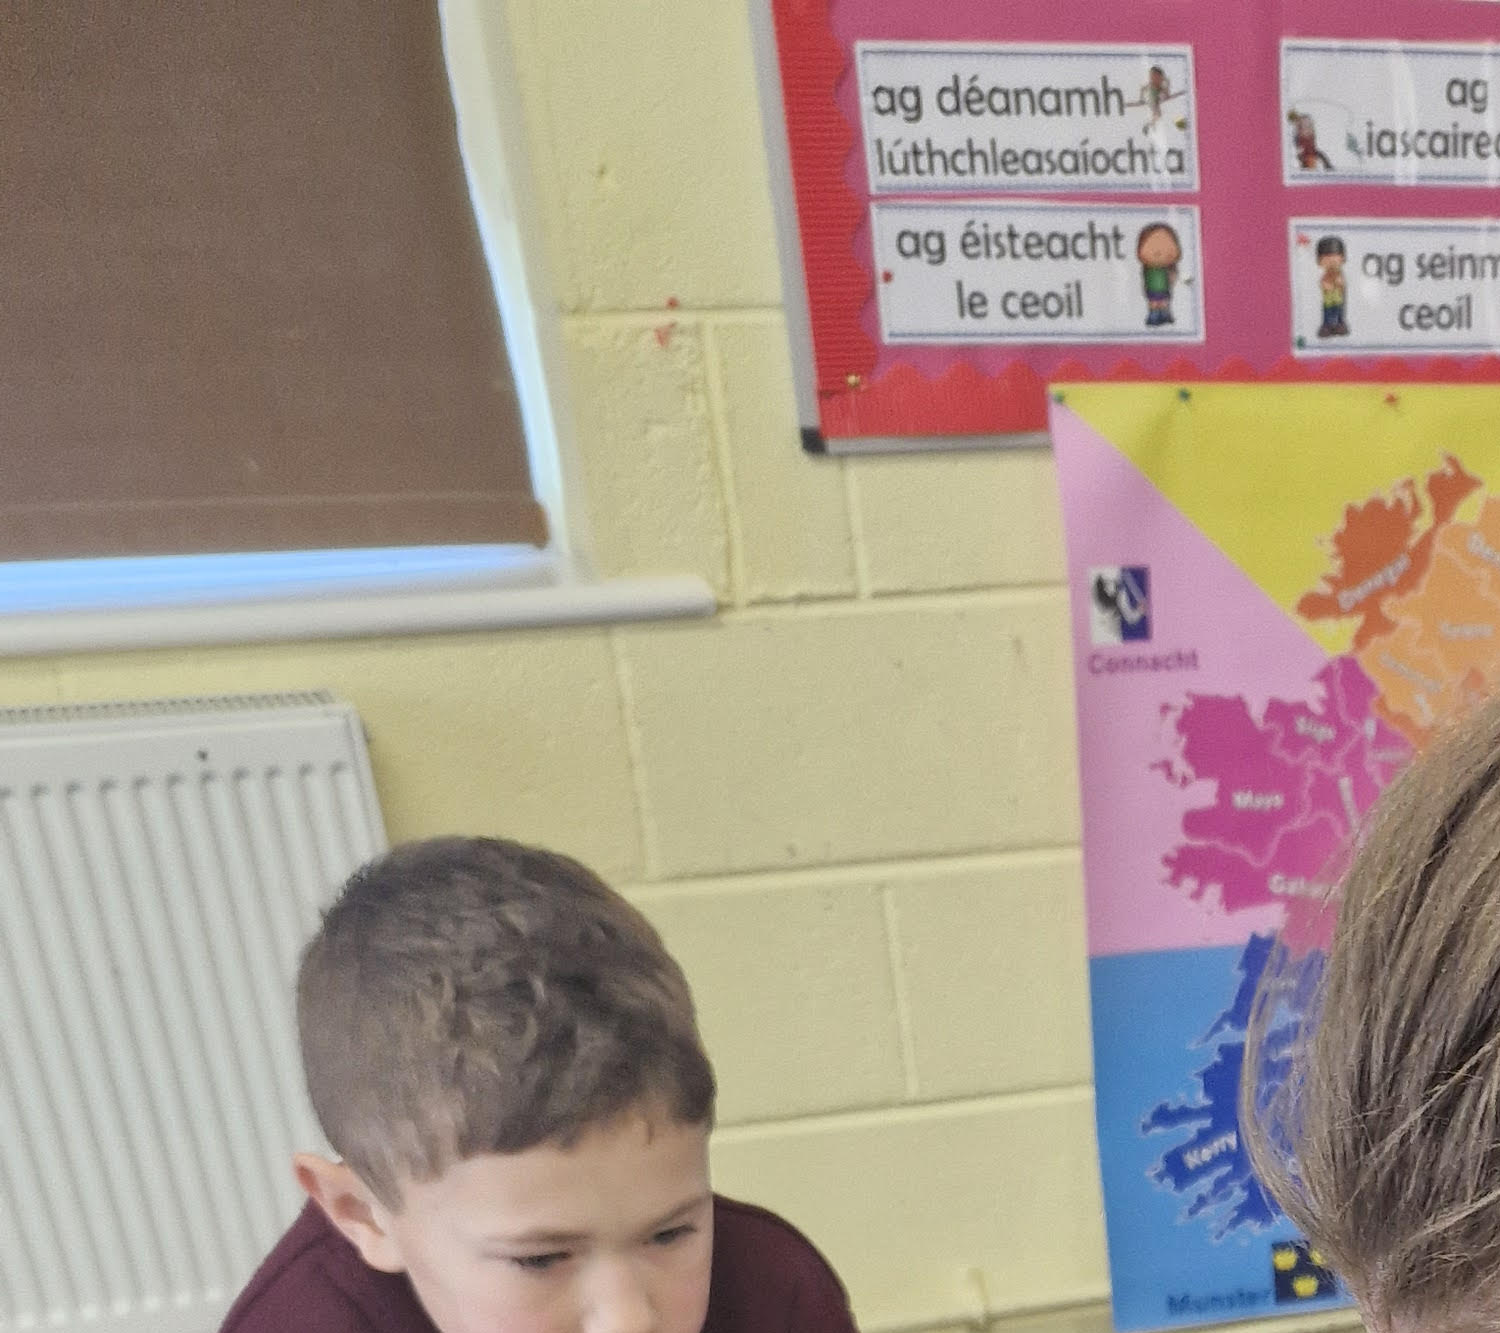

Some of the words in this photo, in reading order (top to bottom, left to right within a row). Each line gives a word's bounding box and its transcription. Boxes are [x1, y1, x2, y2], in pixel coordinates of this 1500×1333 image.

[872, 85, 923, 123] ag
[937, 73, 1124, 117] déanamh
[1446, 77, 1489, 114] ag
[876, 137, 1185, 176] lúthchleasaíochta
[896, 228, 946, 266] ag
[960, 220, 1126, 261] éisteacht
[1362, 252, 1404, 286] ag
[956, 280, 988, 320] le
[1001, 280, 1083, 320] ceoil
[1400, 293, 1472, 331] ceoil
[1088, 650, 1198, 675] Connacht
